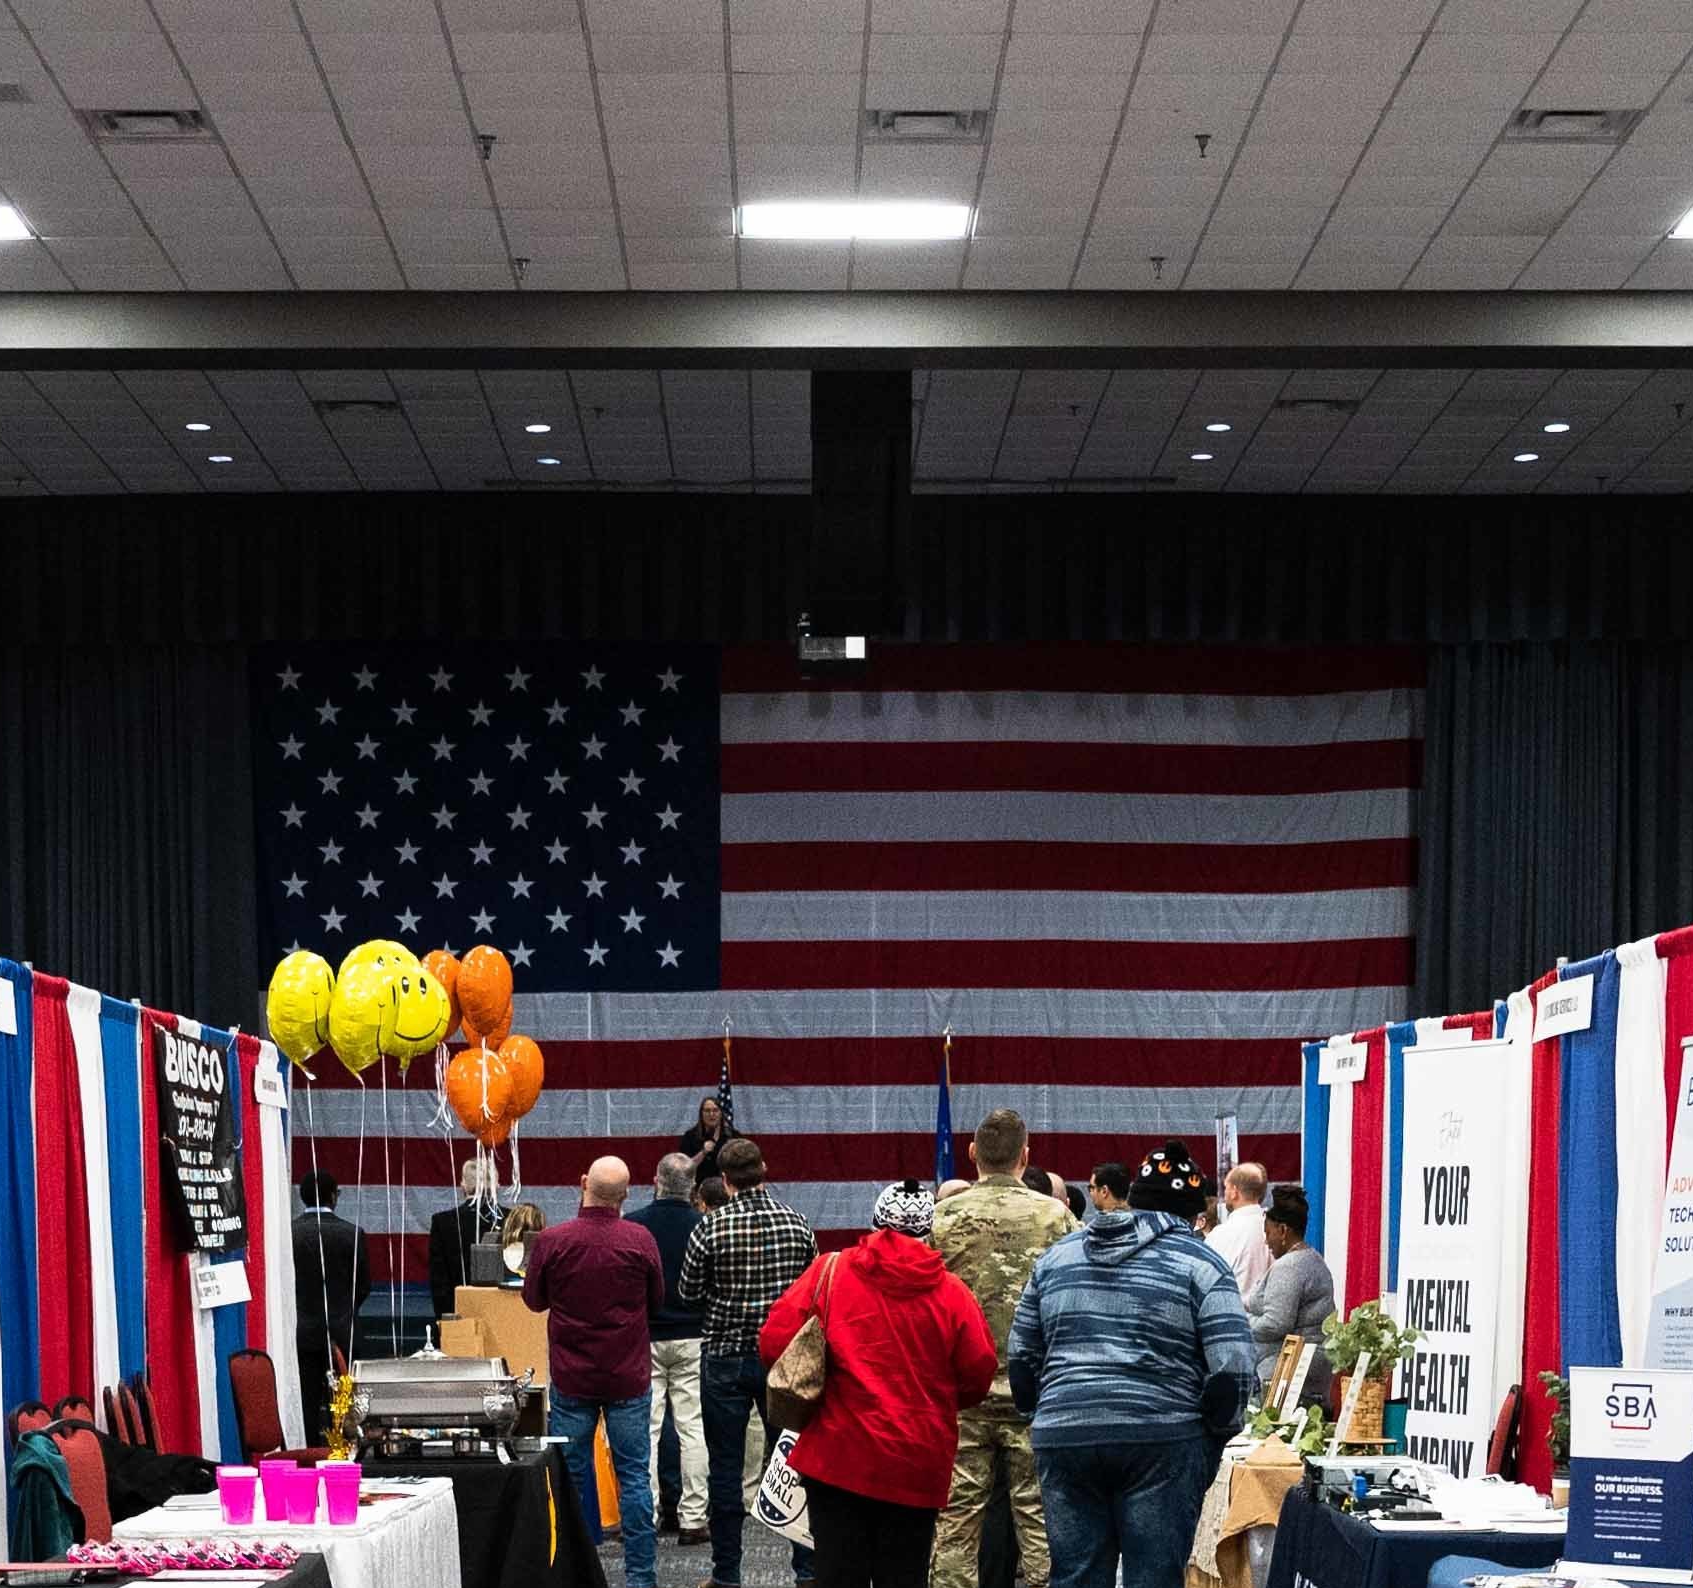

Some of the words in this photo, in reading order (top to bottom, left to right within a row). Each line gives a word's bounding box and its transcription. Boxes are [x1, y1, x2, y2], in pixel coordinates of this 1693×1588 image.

[1423, 1165, 1470, 1226] YOUR
[1406, 1279, 1471, 1333] MENTAL
[1680, 1306, 1693, 1317] BLUE
[1401, 1352, 1471, 1415] HEALTH
[1605, 1395, 1657, 1418] SBA
[766, 1471, 793, 1510] SMALL
[1594, 1484, 1616, 1493] OUR
[1617, 1485, 1664, 1496] BUSINESS.
